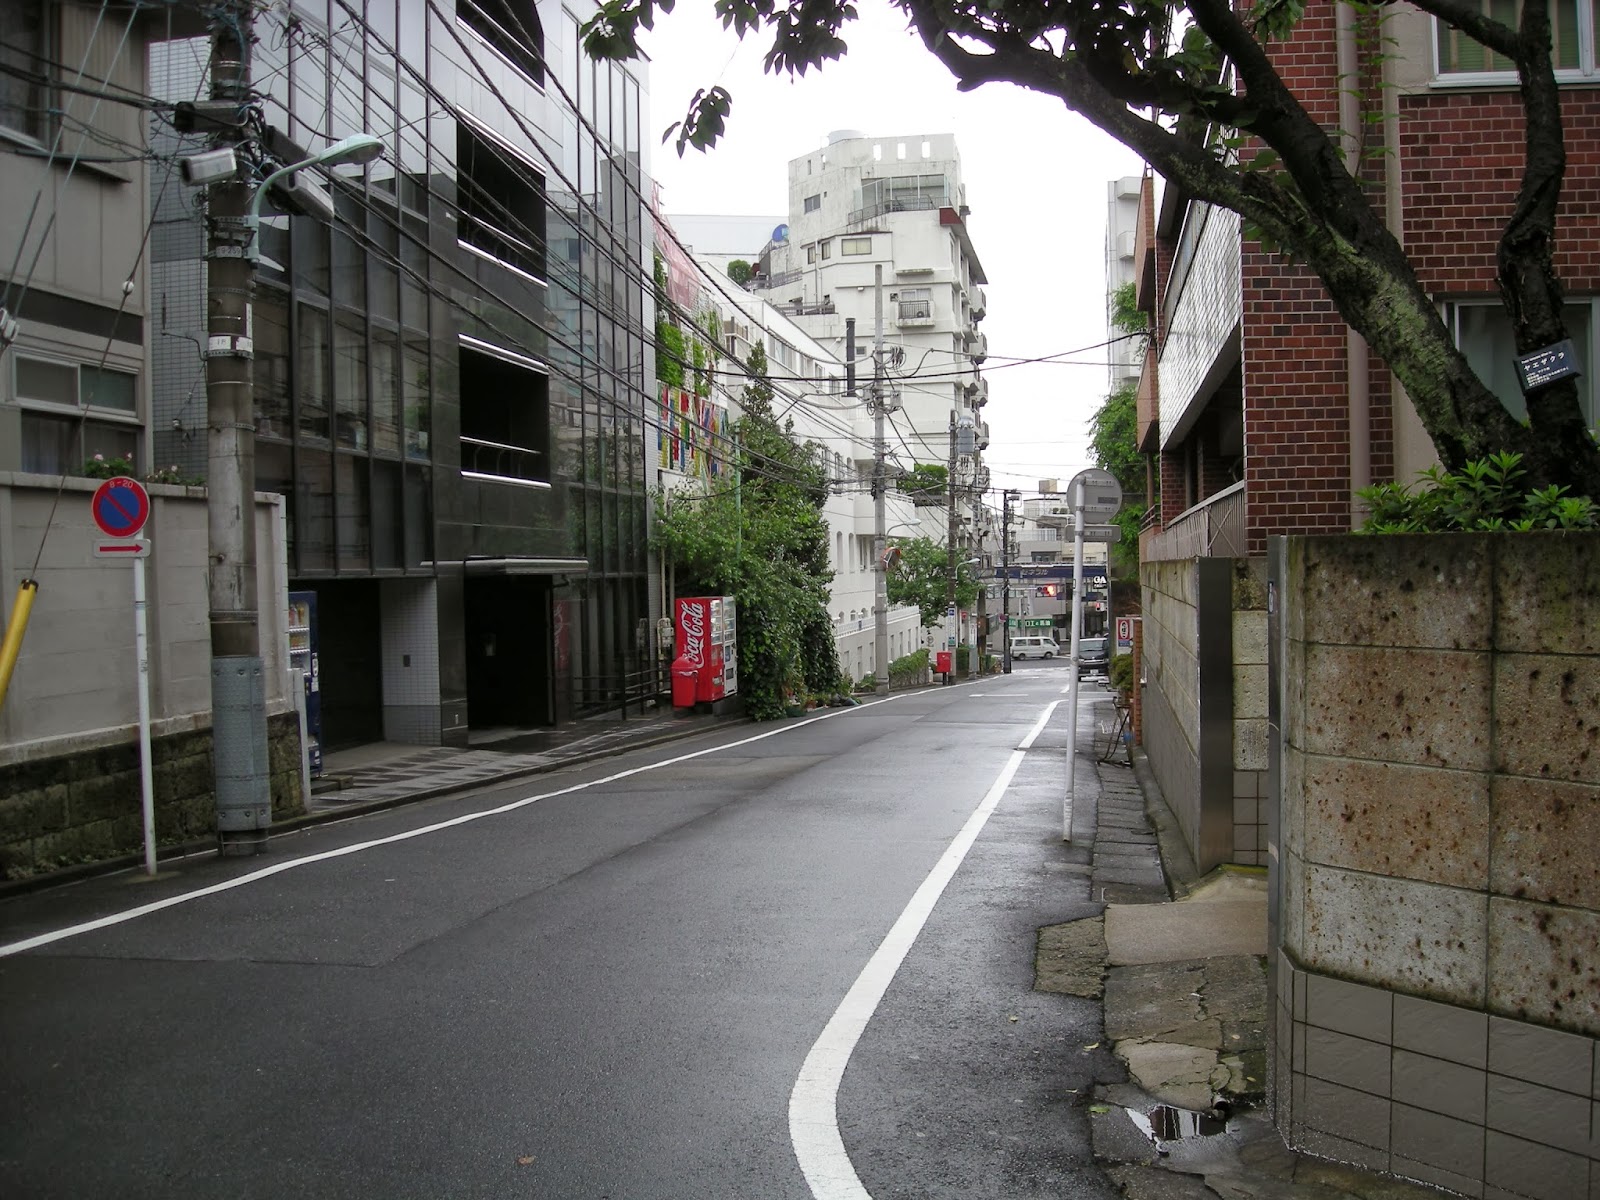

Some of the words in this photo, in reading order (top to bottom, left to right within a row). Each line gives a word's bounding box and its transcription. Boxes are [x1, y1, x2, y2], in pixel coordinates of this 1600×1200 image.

[109, 479, 134, 489] 8-20
[1093, 575, 1107, 583] GA
[681, 600, 704, 668] oca-Cola
